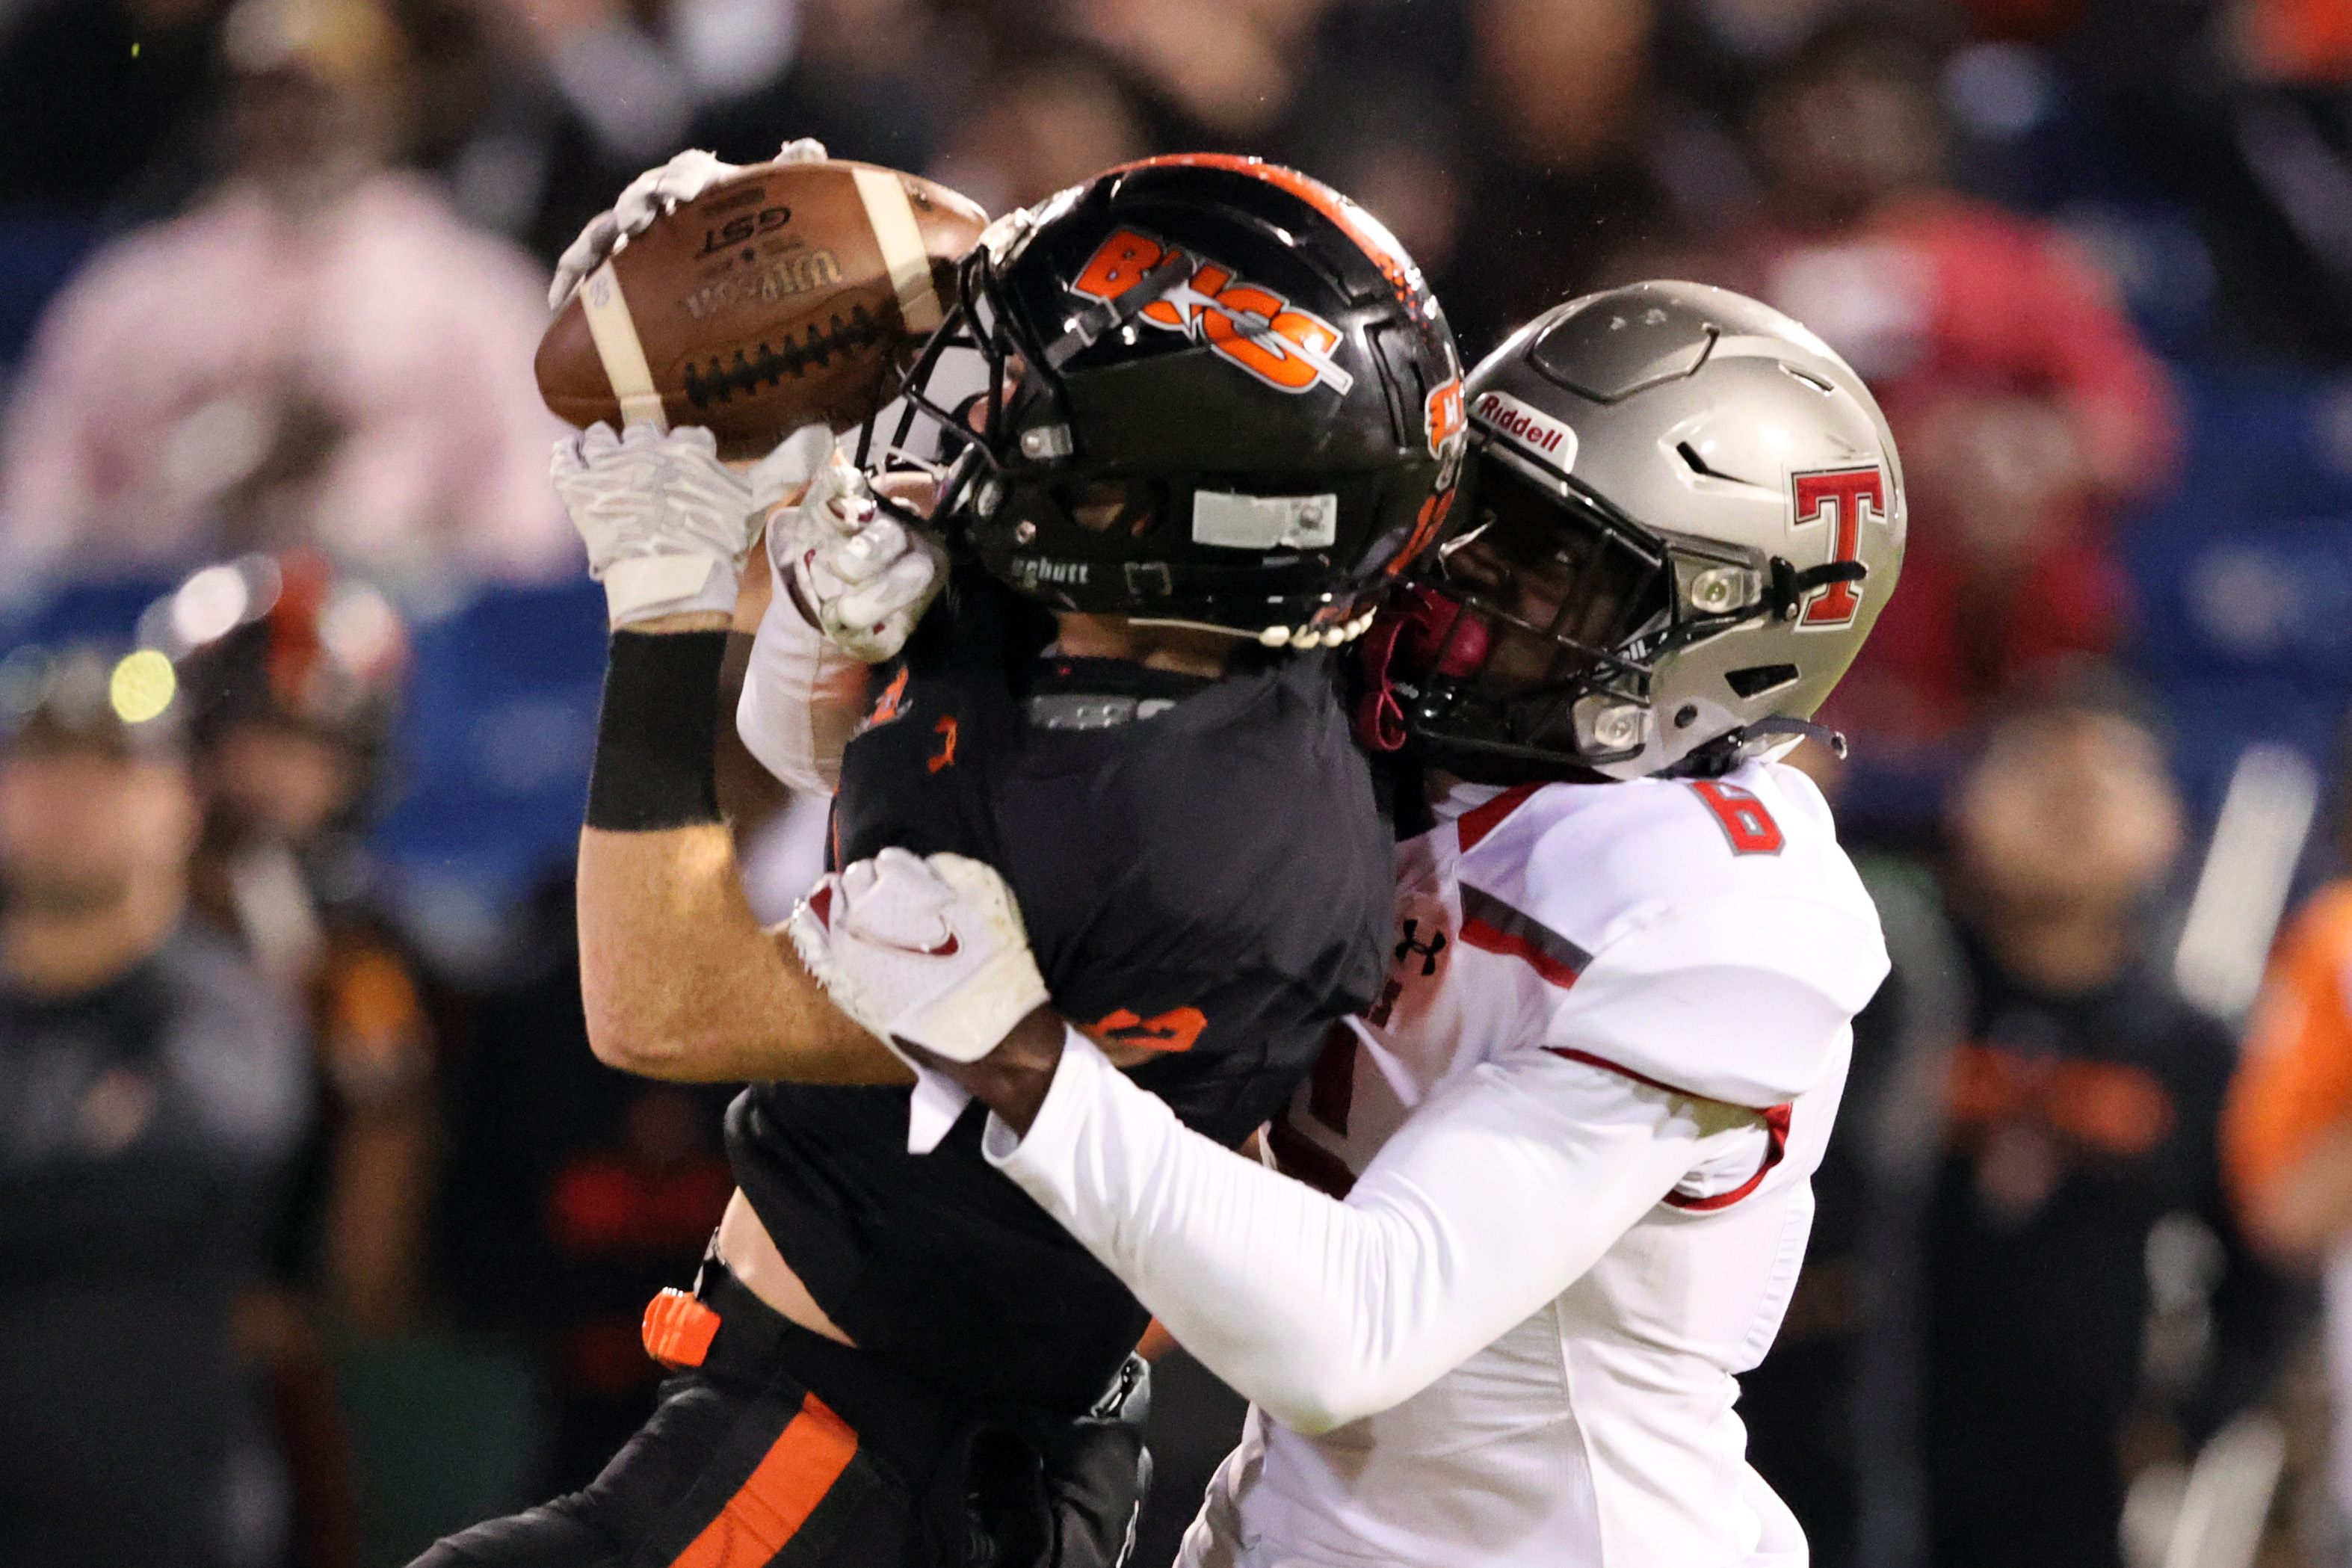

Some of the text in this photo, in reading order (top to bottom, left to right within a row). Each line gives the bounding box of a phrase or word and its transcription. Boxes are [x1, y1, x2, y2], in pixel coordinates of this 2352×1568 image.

[695, 207, 791, 259] GST
[1479, 395, 1564, 451] Riddell
[1791, 464, 1885, 627] T
[1687, 780, 1787, 857] 6
